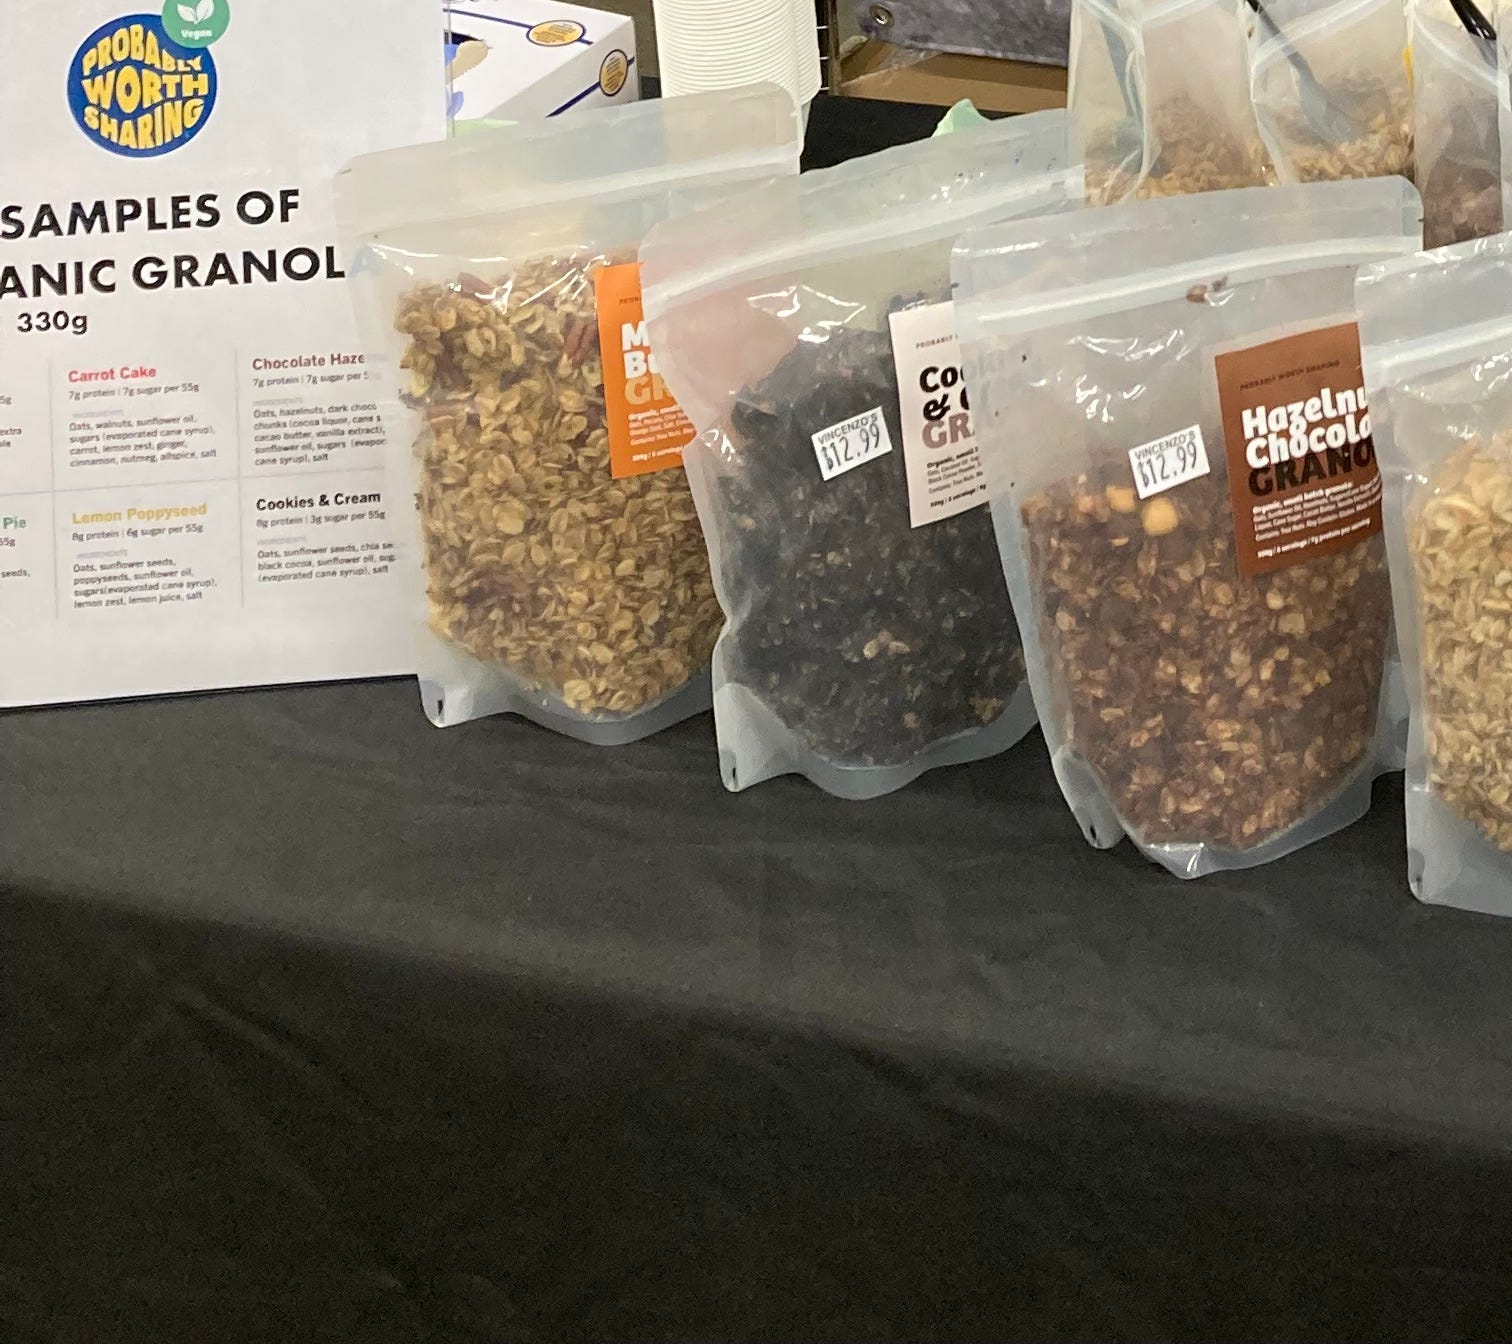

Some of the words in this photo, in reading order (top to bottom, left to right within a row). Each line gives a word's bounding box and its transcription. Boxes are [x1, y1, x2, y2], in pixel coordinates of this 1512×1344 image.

[82, 24, 202, 76] PROBABLY
[82, 65, 208, 113] WORTH
[84, 98, 205, 150] SHARING
[0, 193, 220, 240] SAMPLES
[236, 189, 300, 225] OF
[17, 311, 88, 336] 330g
[68, 368, 115, 383] Carrot
[120, 366, 156, 379] Cake
[252, 355, 326, 370] Chocolate
[82, 388, 115, 399] protein
[137, 386, 161, 396] sugar
[164, 385, 179, 395] per
[919, 365, 964, 393] Co
[817, 412, 879, 445] VINCENZO'S
[922, 412, 976, 449] GR
[821, 423, 880, 471] $12.99
[1134, 430, 1197, 459] VINCENZO'S
[1138, 442, 1198, 488] $12.99
[72, 511, 122, 525] Lemon
[127, 504, 207, 522] Poppyseed
[256, 496, 314, 511] Cookies
[318, 494, 330, 506] &
[334, 492, 381, 505] Cream
[2, 517, 26, 529] Pie
[324, 513, 349, 522] sugar
[351, 512, 366, 522] per
[86, 530, 119, 541] protein
[140, 527, 165, 538] sugar
[168, 525, 183, 535] per
